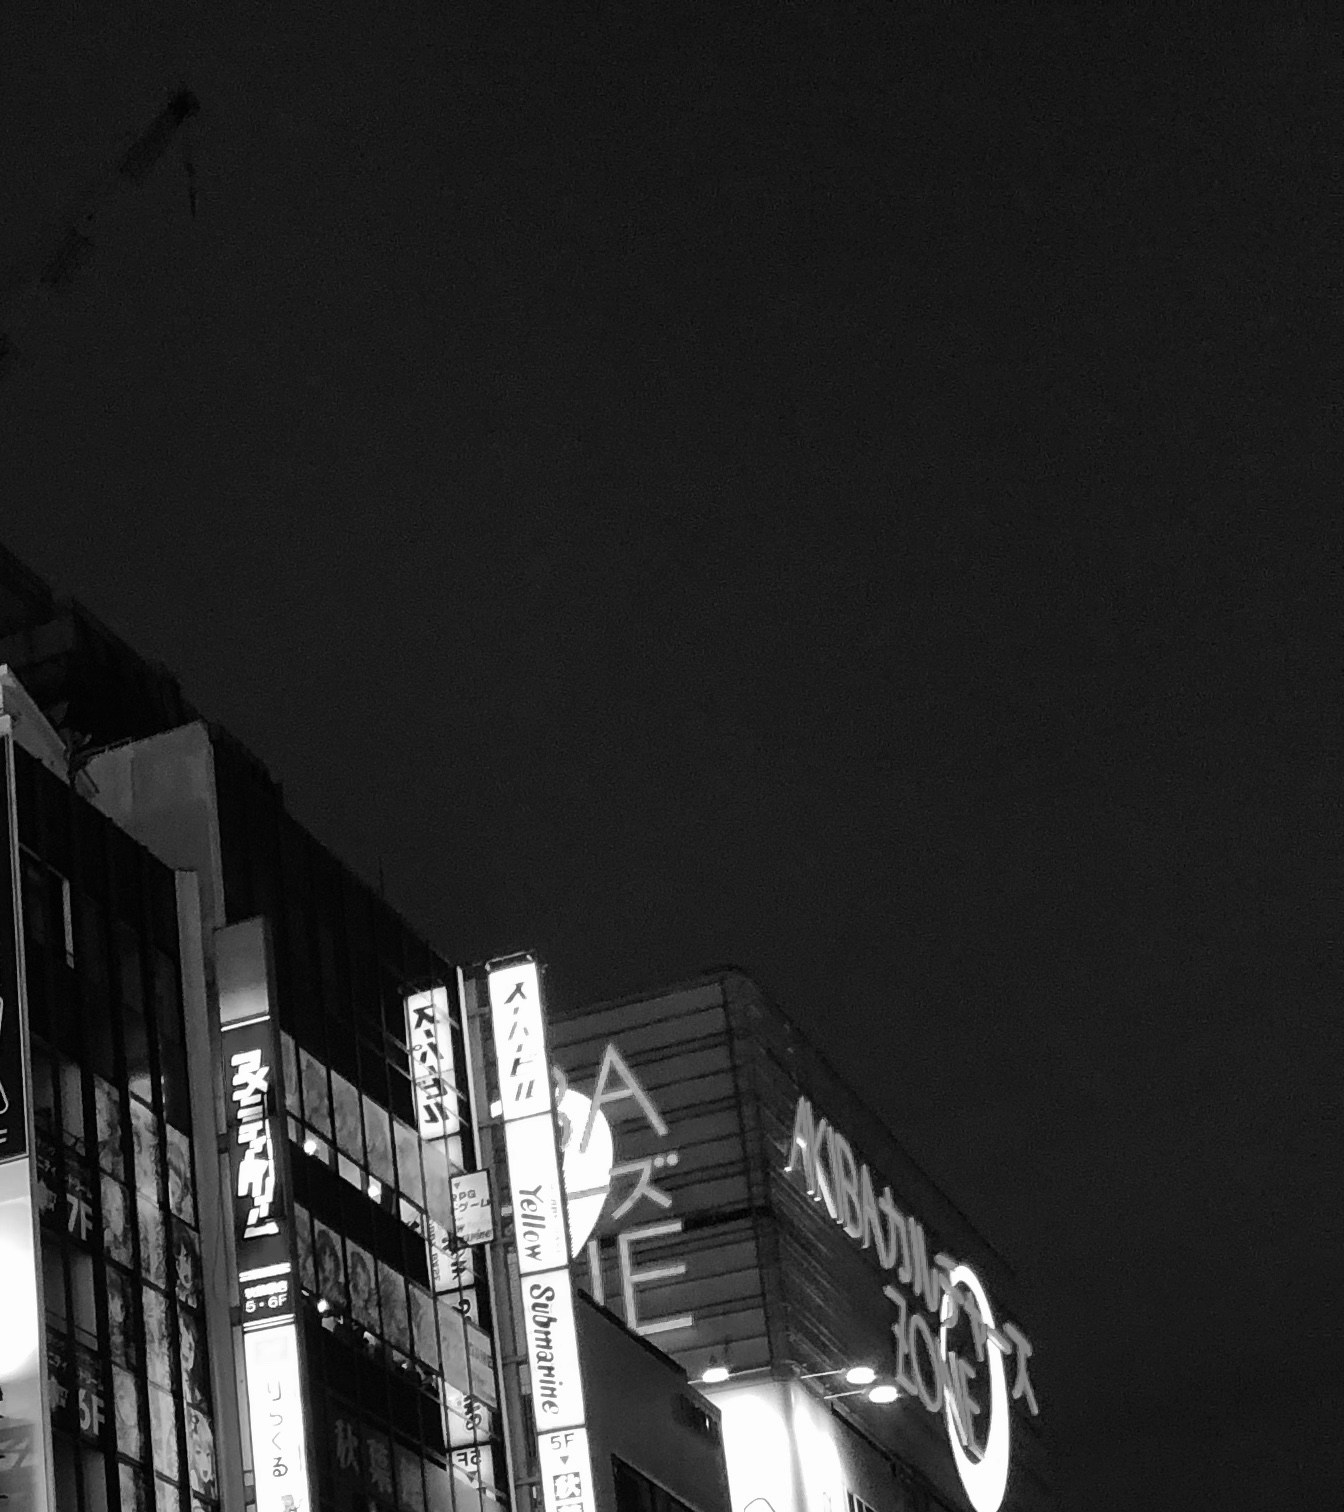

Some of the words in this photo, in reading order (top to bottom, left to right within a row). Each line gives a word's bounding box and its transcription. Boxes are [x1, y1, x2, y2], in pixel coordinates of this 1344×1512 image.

[518, 1184, 547, 1262] Yellow
[528, 1282, 561, 1415] Submarine
[550, 1433, 575, 1451] 5F
